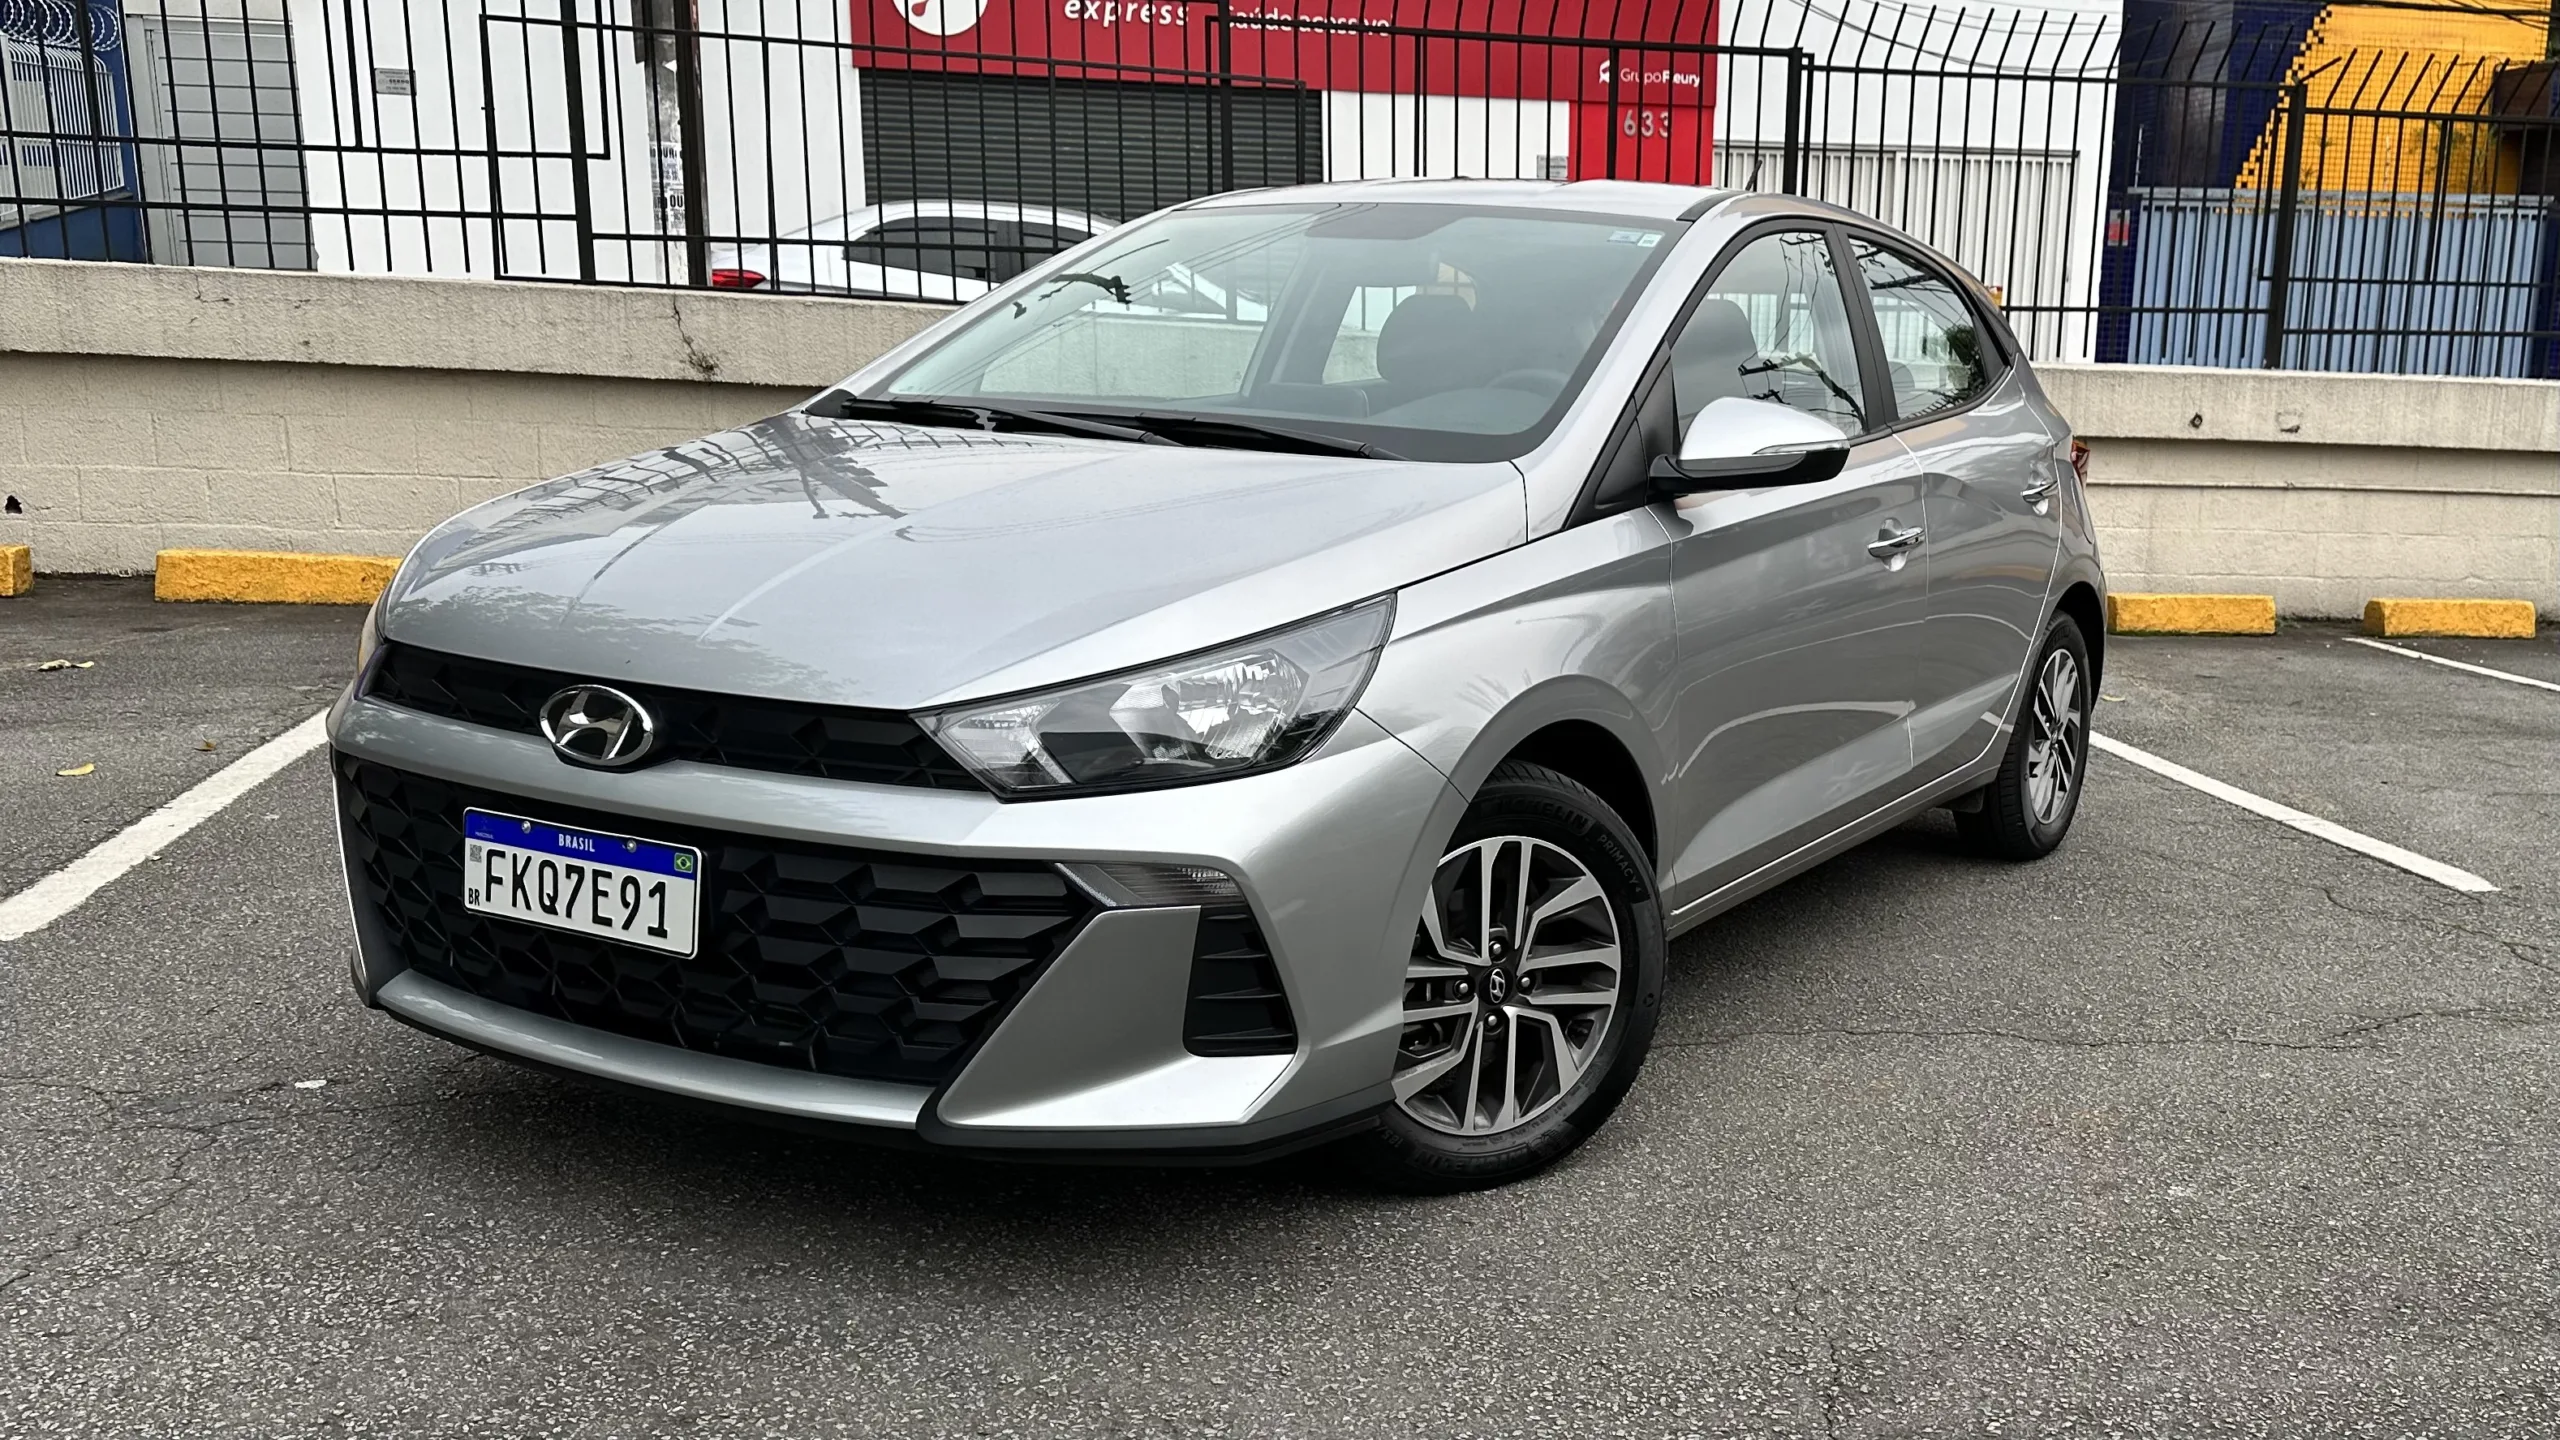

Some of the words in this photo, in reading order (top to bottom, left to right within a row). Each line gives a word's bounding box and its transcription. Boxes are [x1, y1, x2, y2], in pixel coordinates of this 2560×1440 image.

[1064, 0, 1189, 27] express
[1227, 6, 1292, 31] aúde
[1624, 109, 1669, 138] 633
[558, 833, 596, 853] BRASIL
[1597, 833, 1640, 885] PRIMACY
[468, 887, 481, 907] BR
[485, 848, 669, 940] FKQ7E91
